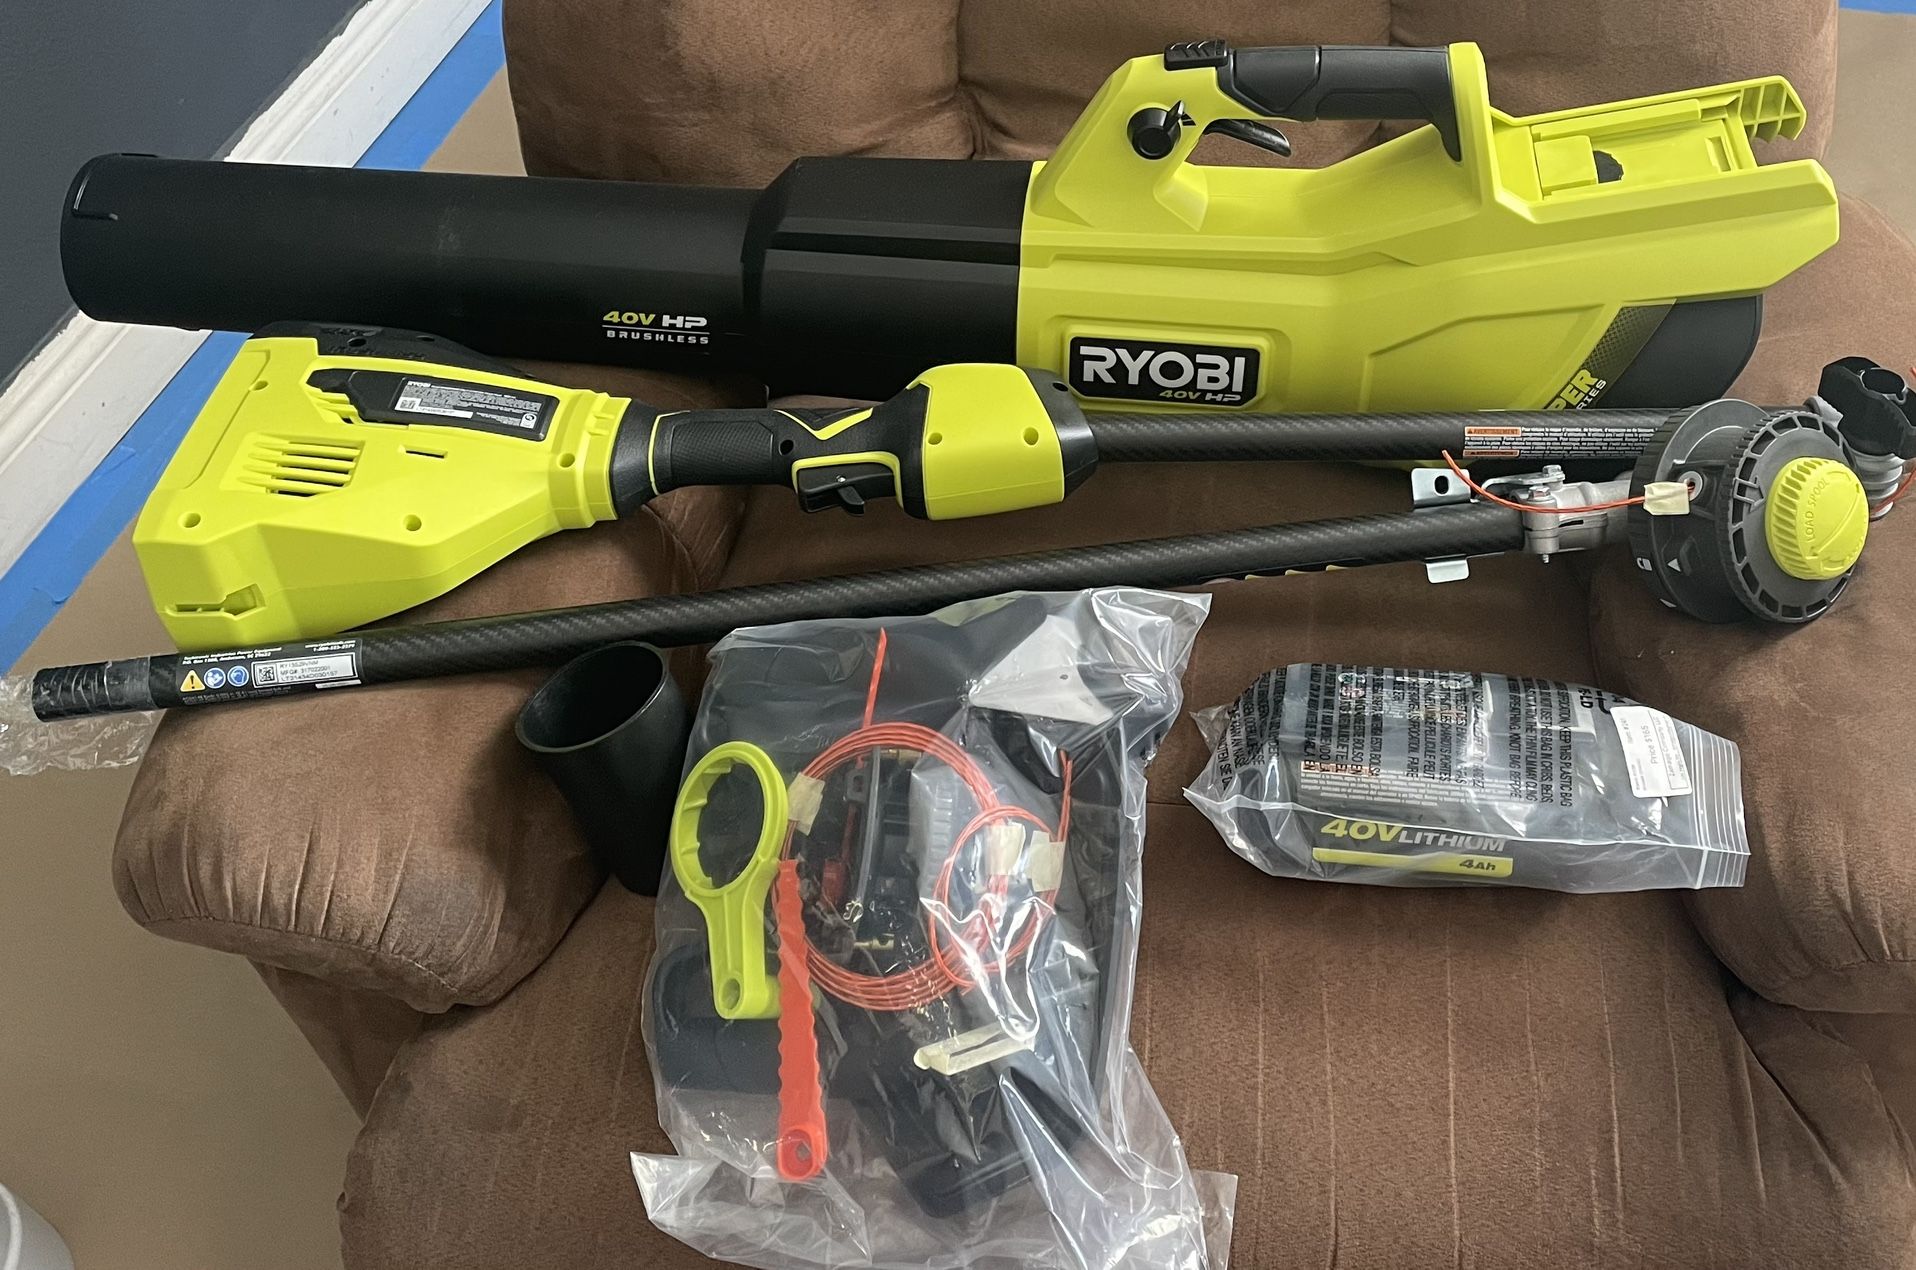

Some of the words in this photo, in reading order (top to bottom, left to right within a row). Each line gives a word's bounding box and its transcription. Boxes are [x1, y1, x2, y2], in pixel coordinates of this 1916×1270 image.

[602, 311, 656, 326] 40V
[661, 314, 708, 328] HP
[606, 330, 709, 344] BRUSHLESS
[1079, 345, 1246, 393] RYOBI
[1159, 390, 1202, 400] 40V
[1205, 392, 1242, 402] HP
[1808, 477, 1831, 507] SPOOL
[1804, 511, 1815, 543] LOAD
[1540, 708, 1551, 720] USE
[1525, 721, 1536, 733] THE
[1558, 725, 1571, 744] KEEP
[1640, 723, 1652, 743] $165
[1350, 737, 1366, 763] BOLSO
[1508, 732, 1520, 752] KNOT
[1524, 734, 1536, 751] THIN
[1540, 736, 1551, 751] BAG
[1508, 753, 1520, 768] BAG
[1540, 752, 1551, 760] IN
[1559, 744, 1571, 760] THIS
[1646, 743, 1658, 765] Price
[1405, 755, 1420, 778] FAIRE
[1421, 759, 1436, 780] PEUT
[1559, 761, 1572, 790] PLASTIC
[1525, 781, 1537, 801] CLING
[1539, 783, 1553, 803] BEDS,
[1559, 792, 1571, 807] BAG
[1319, 818, 1402, 842] 40V
[1398, 830, 1506, 852] LITHIUM
[1459, 857, 1497, 872] 4Ah
